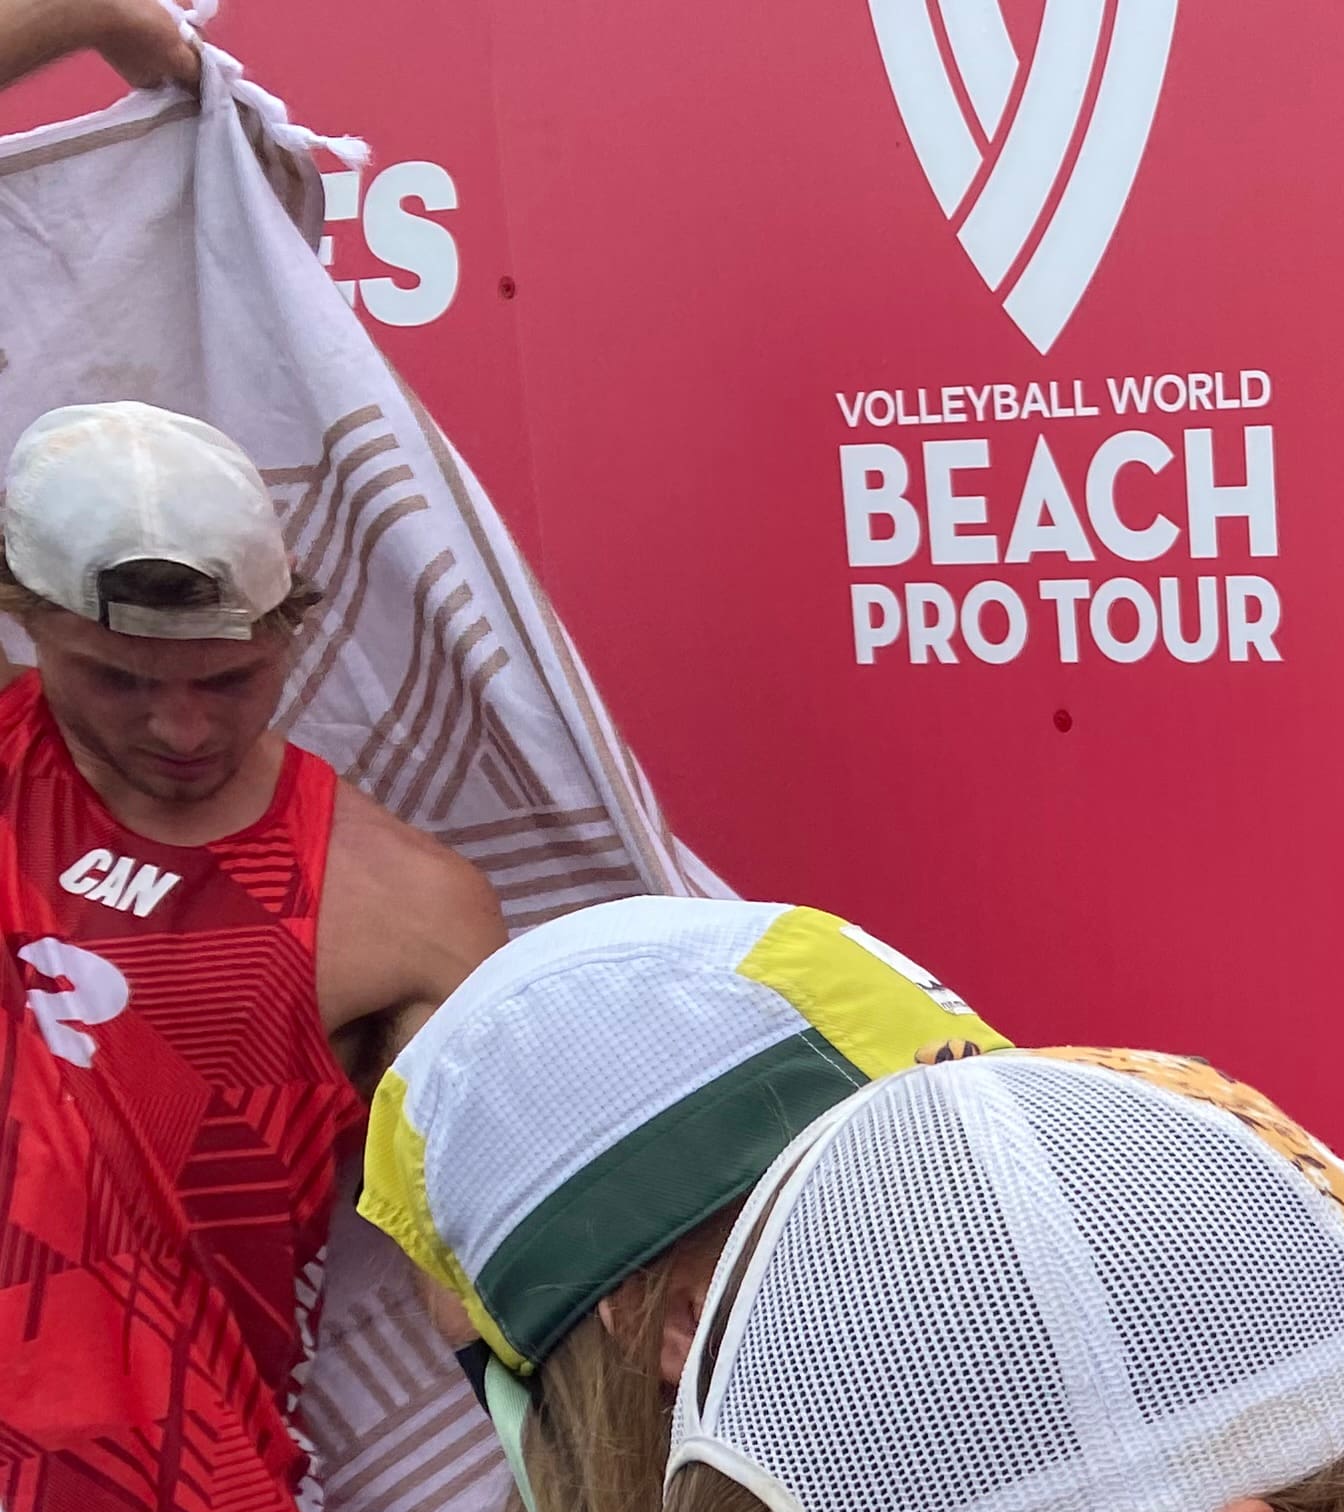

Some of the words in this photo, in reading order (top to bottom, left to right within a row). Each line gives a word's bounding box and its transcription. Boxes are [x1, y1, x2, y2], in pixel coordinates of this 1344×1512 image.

[836, 380, 1099, 428] VOLLEYBALL
[1107, 370, 1272, 415] WORLD
[840, 425, 1279, 567] BEACH
[850, 580, 1028, 665] PRO
[1039, 575, 1283, 664] TOUR
[59, 848, 181, 918] CAN
